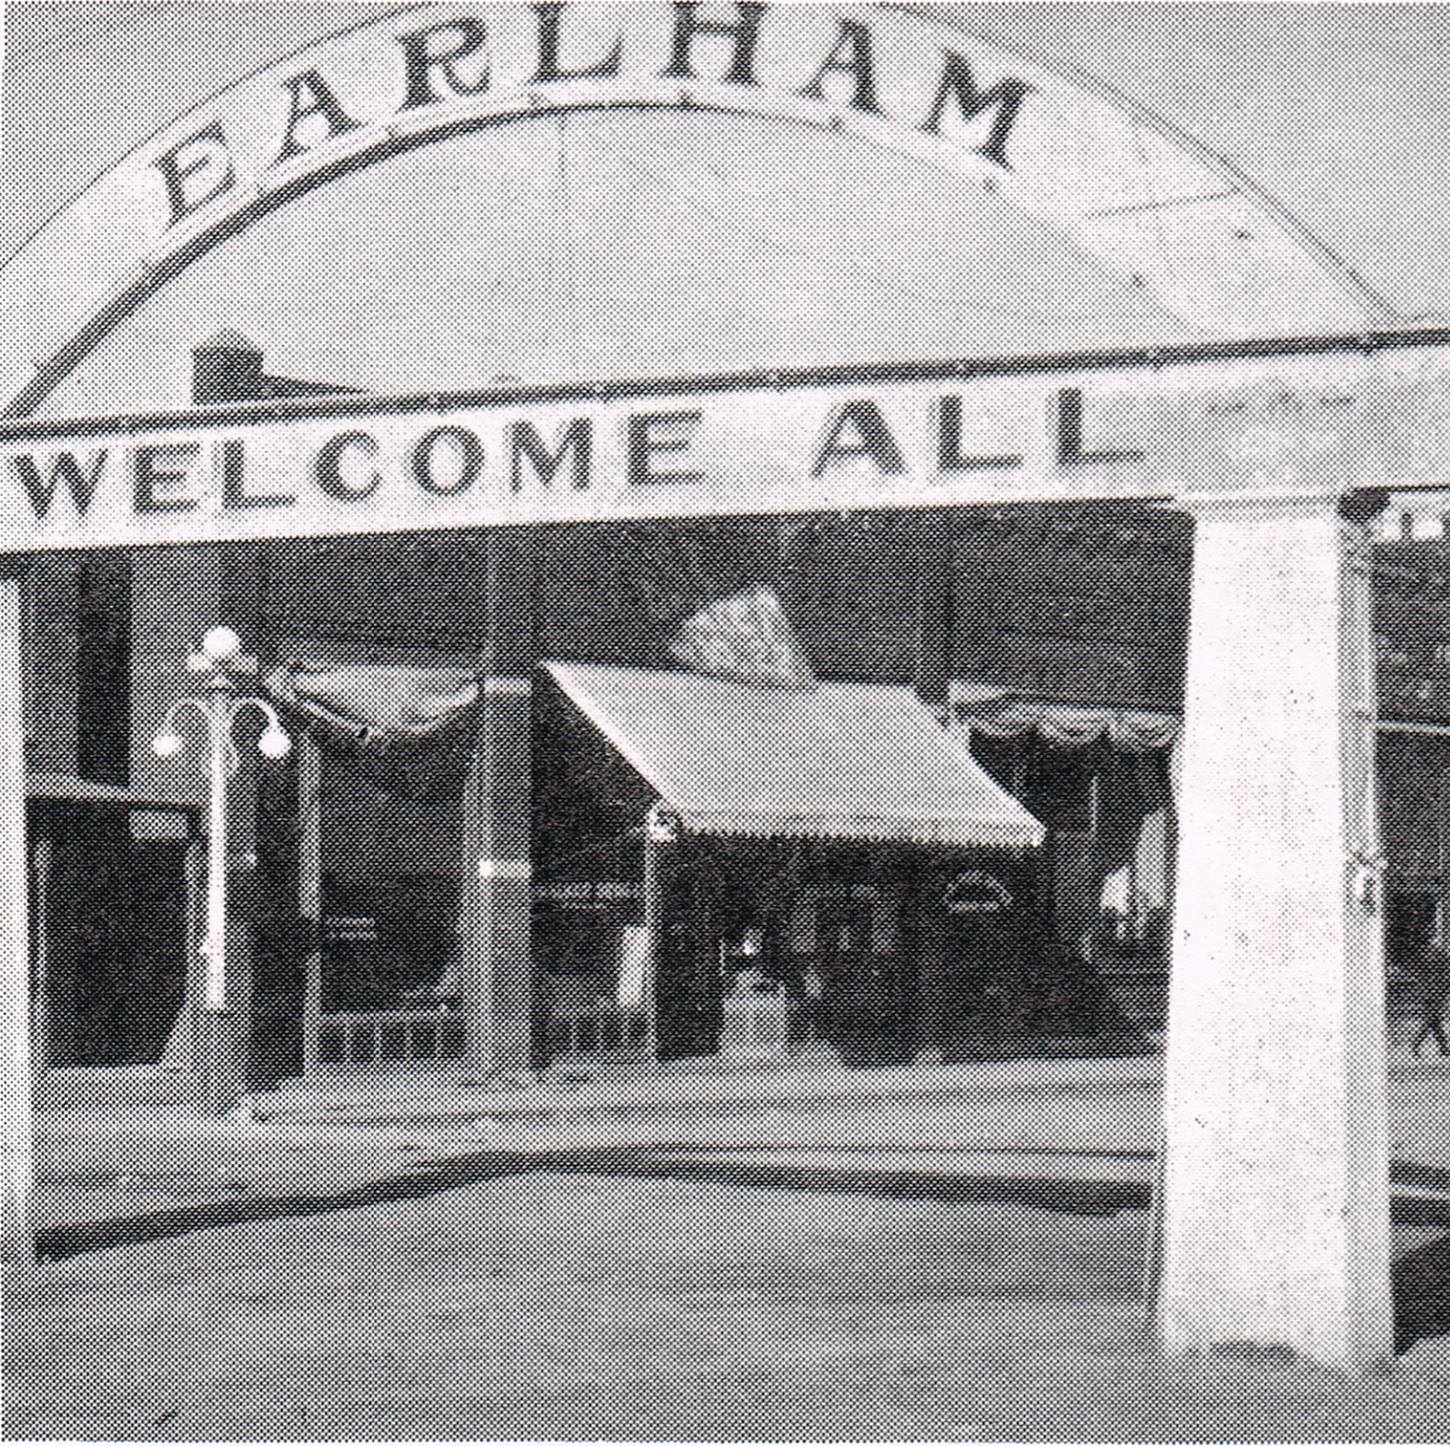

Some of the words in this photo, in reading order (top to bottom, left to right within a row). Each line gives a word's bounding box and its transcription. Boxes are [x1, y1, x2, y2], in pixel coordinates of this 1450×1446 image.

[154, 2, 1030, 225] EARLHAM
[13, 413, 704, 519] WELCOME
[813, 388, 1145, 474] ALL
